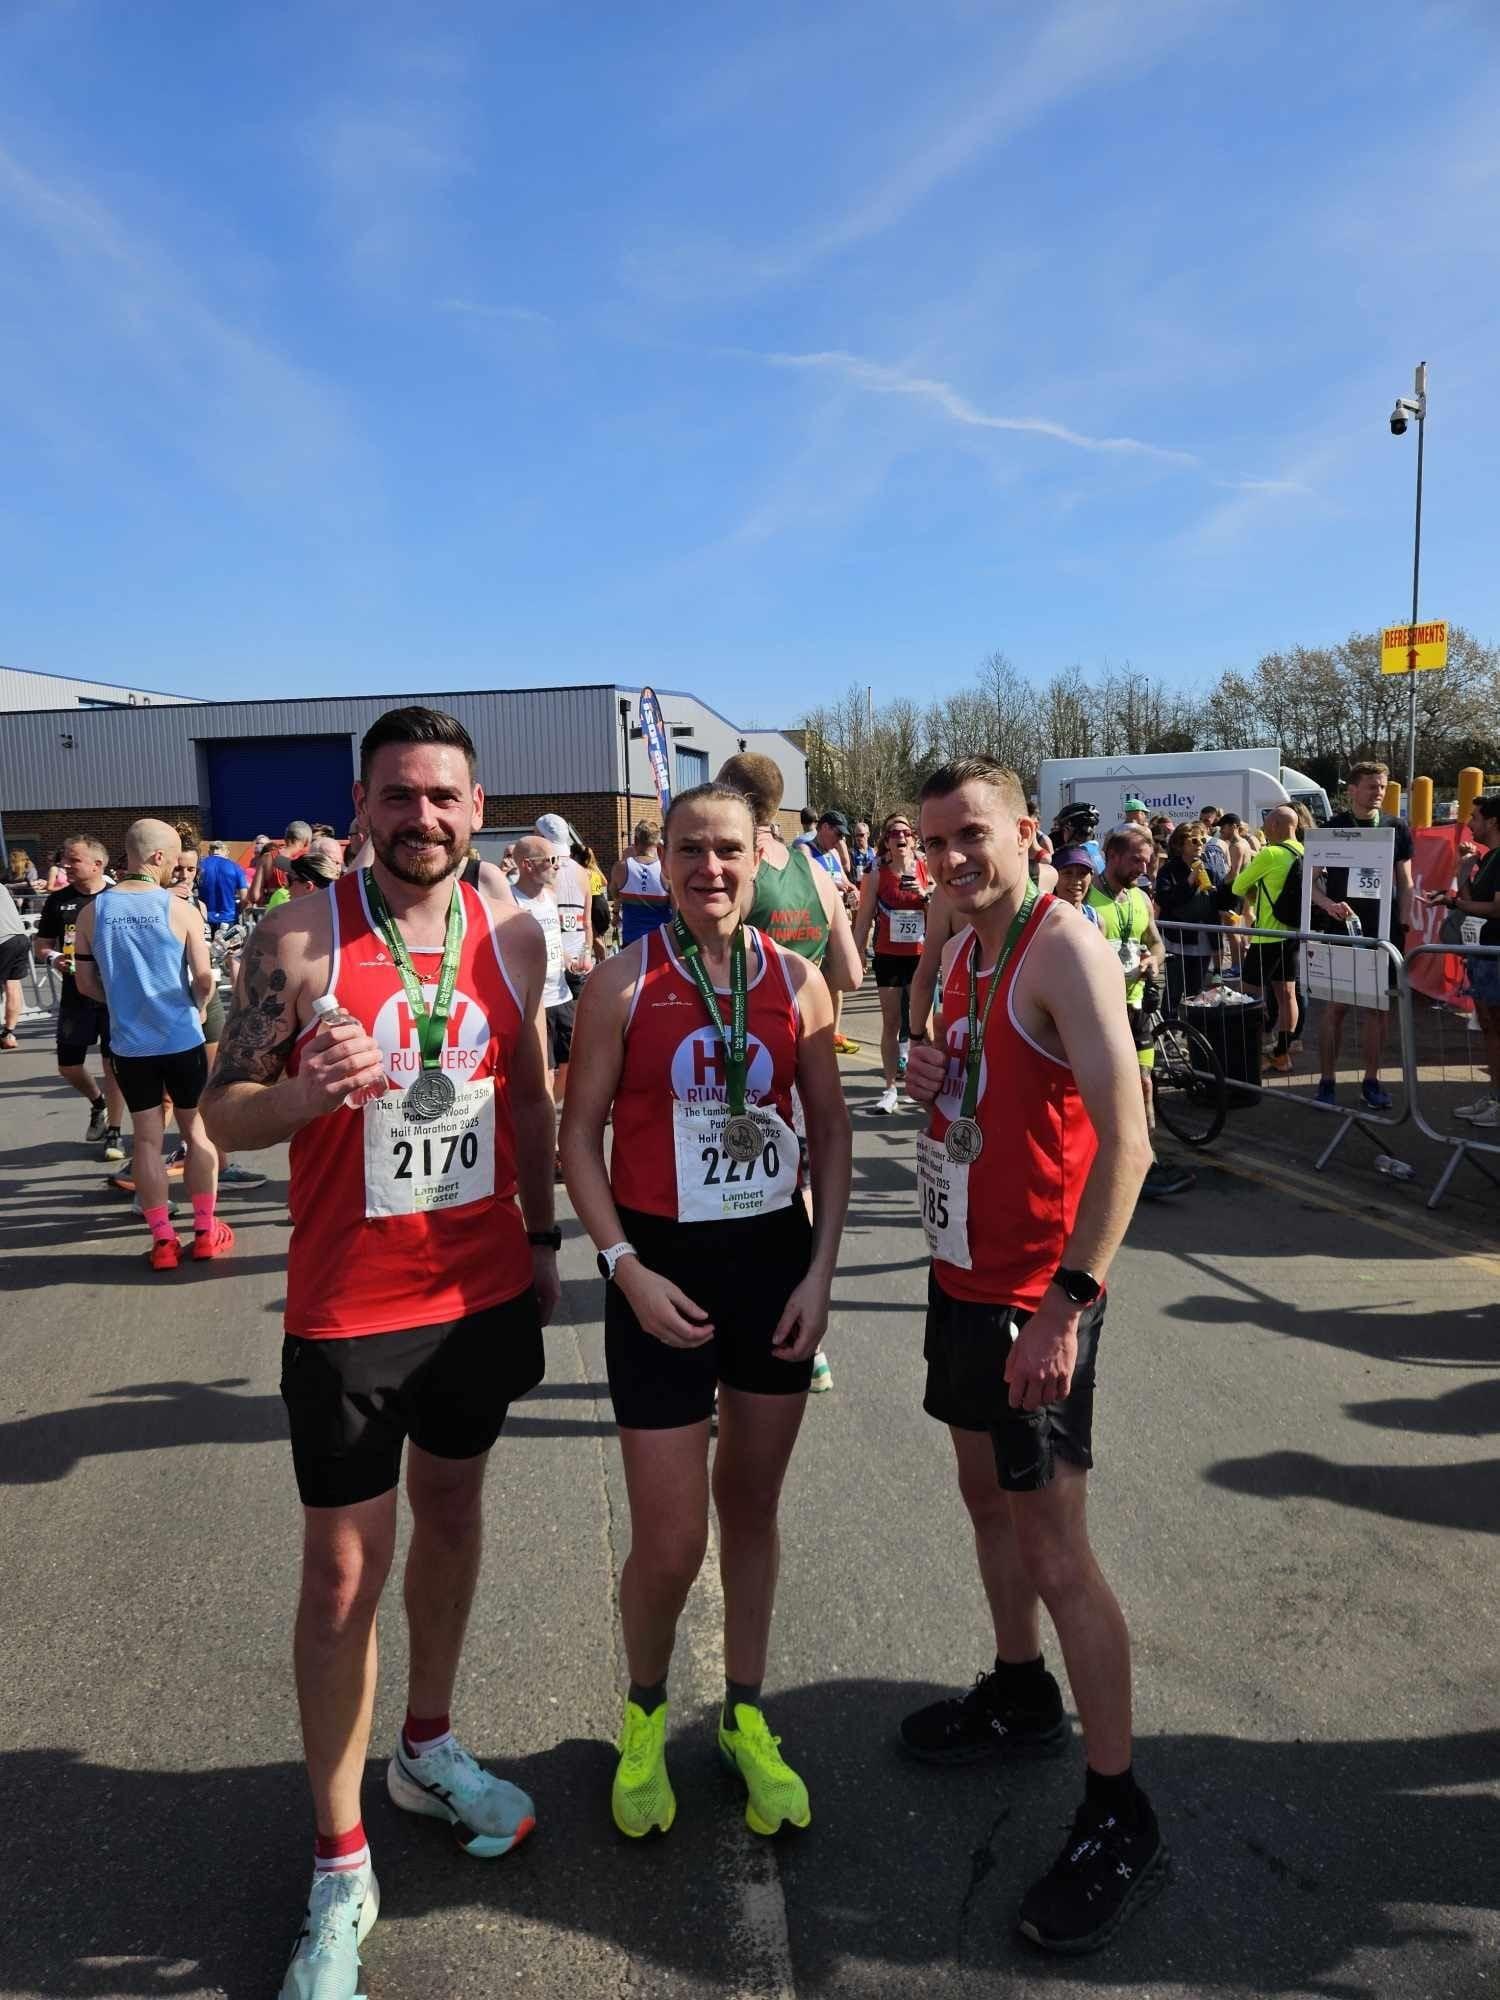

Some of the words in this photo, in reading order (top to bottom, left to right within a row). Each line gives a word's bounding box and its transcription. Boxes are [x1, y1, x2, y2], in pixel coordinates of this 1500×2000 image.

[1359, 877, 1380, 889] 550
[105, 915, 160, 926] CAMBRIDGE
[899, 922, 917, 934] 752
[390, 1050, 480, 1073] RUERS
[377, 1099, 393, 1110] The
[475, 1088, 490, 1099] 35th
[687, 1087, 761, 1105] RUNRS
[685, 1107, 701, 1118] The
[703, 1106, 730, 1116] Lambe
[390, 1126, 411, 1138] Half
[414, 1122, 457, 1136] Marathon
[460, 1116, 480, 1130] 2025
[698, 1133, 717, 1144] Half
[762, 1128, 781, 1139] 2025
[392, 1131, 478, 1180] 2170
[414, 1181, 459, 1197] Lambert
[936, 1176, 951, 1191] 2025
[425, 1192, 459, 1205] Foster
[722, 1189, 764, 1202] Lambert
[733, 1200, 764, 1211] Foster
